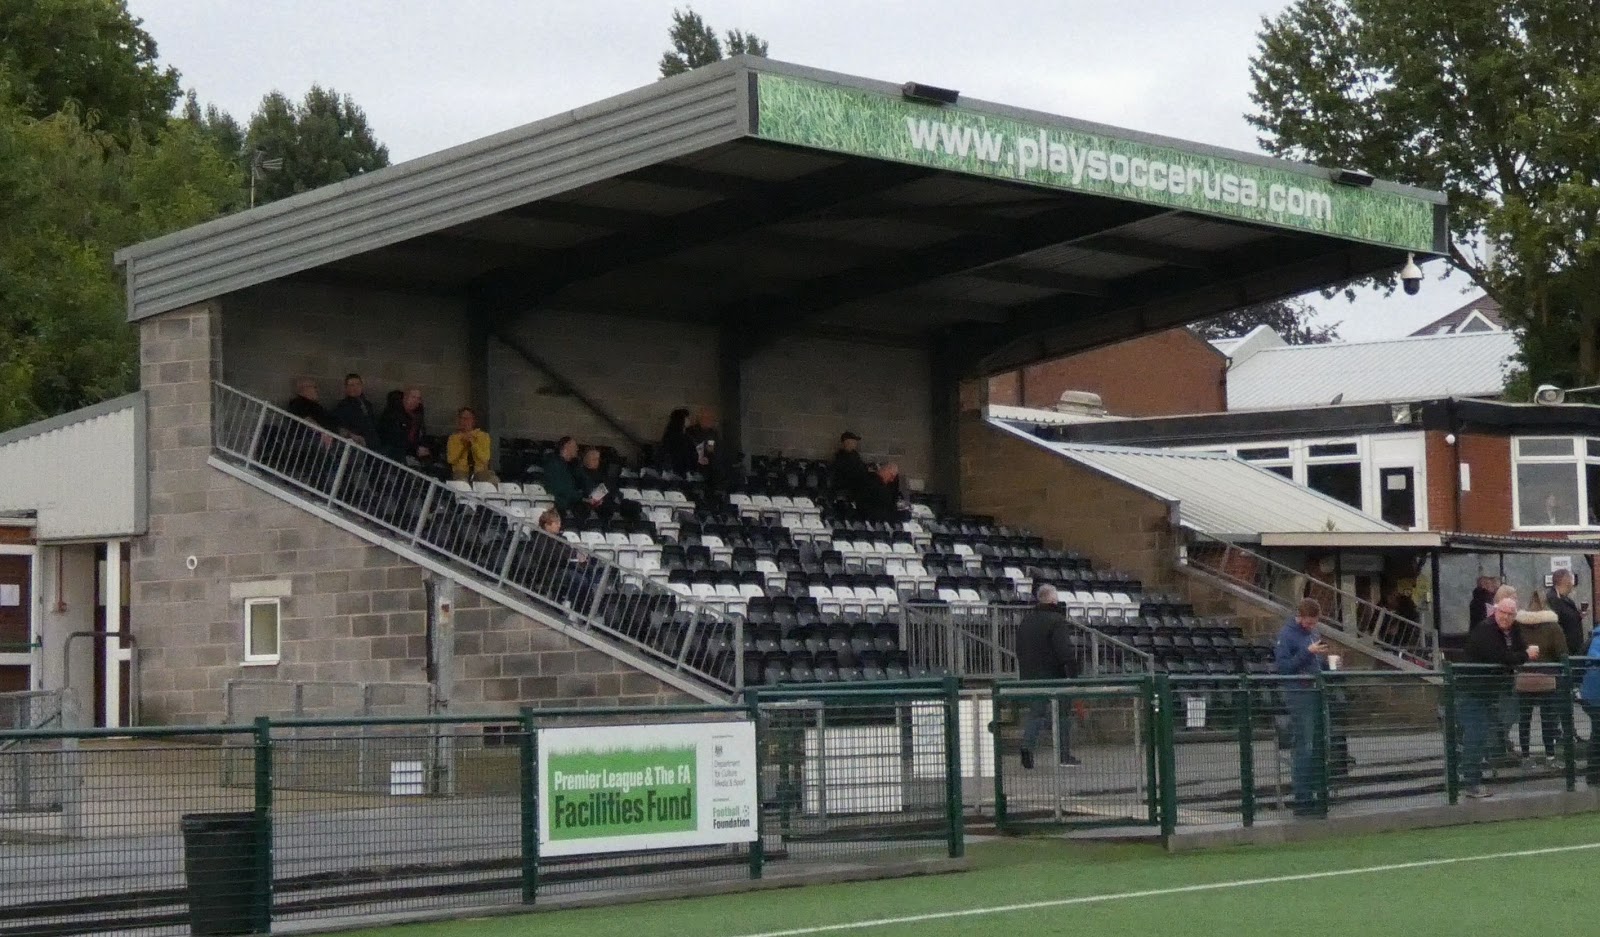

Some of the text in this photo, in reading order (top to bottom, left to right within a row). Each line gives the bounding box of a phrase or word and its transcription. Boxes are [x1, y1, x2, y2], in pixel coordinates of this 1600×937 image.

[907, 116, 1332, 220] www.playsoccerusa.com
[554, 765, 691, 793] Premier League & The FA
[555, 788, 691, 829] Facilities Fund
[712, 805, 740, 818] Football
[713, 818, 750, 829] Foundation
